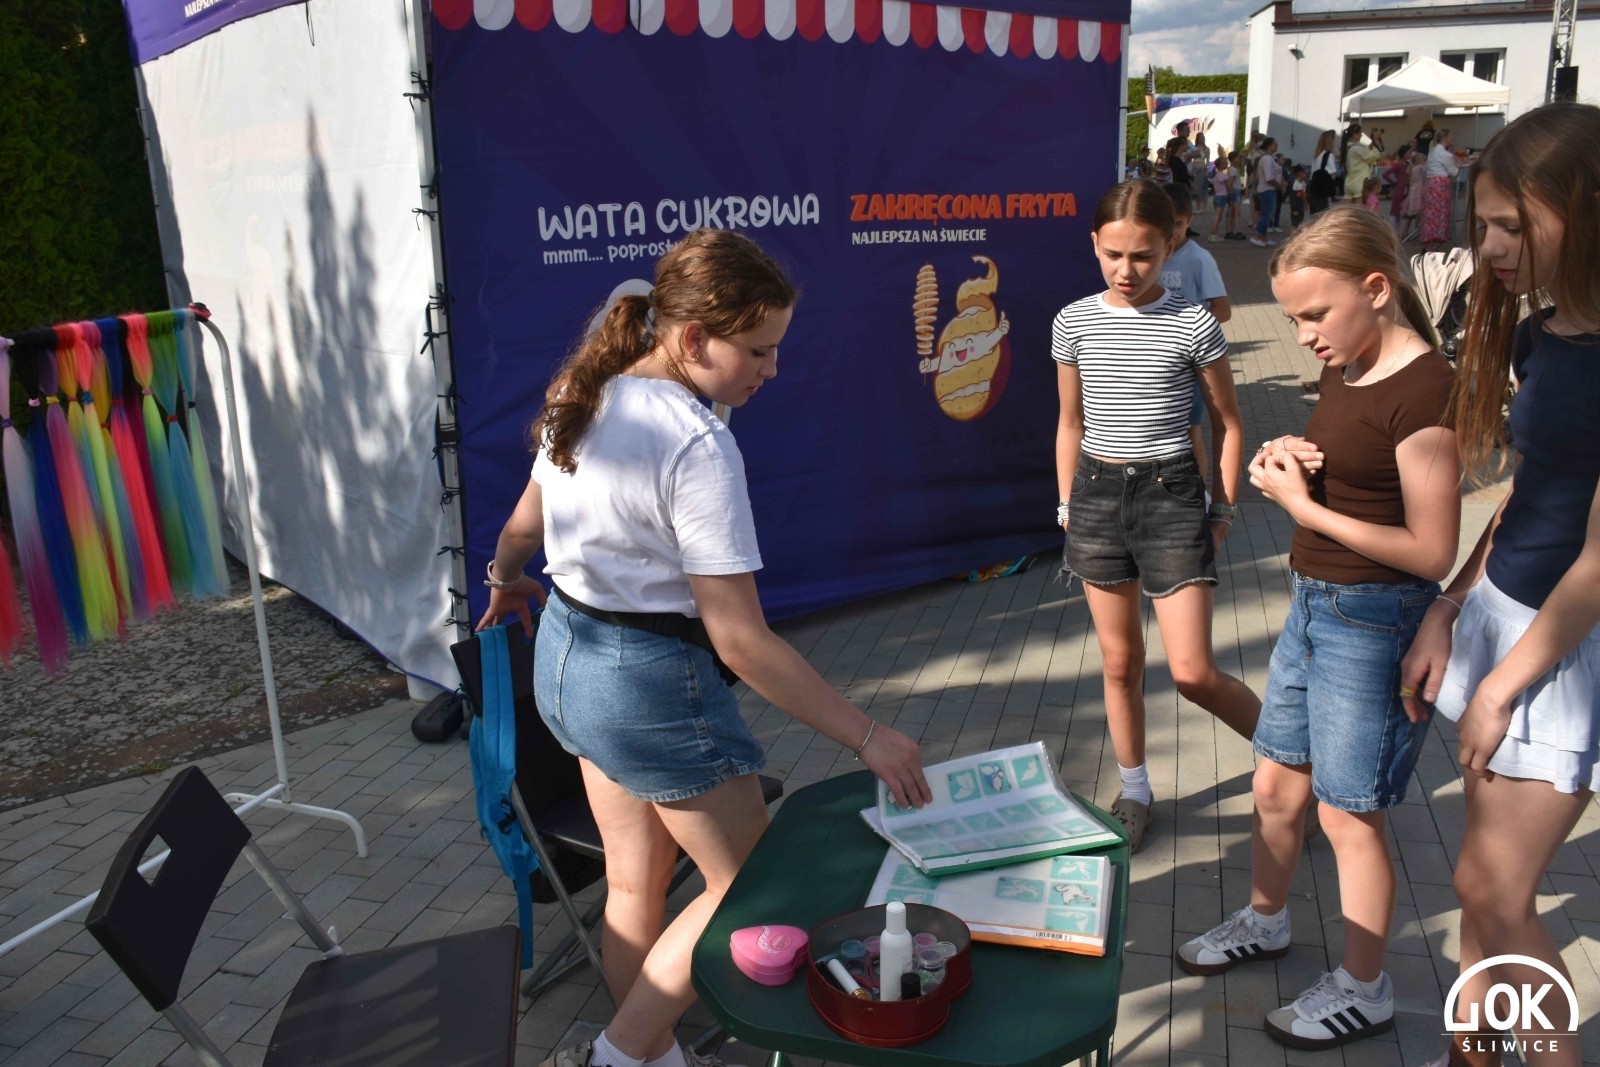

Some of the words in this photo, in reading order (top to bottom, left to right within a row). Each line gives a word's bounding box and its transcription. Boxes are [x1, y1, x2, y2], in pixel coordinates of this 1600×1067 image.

[537, 201, 646, 241] WATA
[656, 193, 820, 233] CUKROWA
[850, 193, 1001, 226] ZAKRĘCONA
[1006, 193, 1077, 218] FRYTA
[852, 230, 920, 245] NAJLEPSZA
[922, 230, 938, 242] NA
[940, 228, 987, 241] ŚWIECIE
[543, 248, 603, 265] mmm....
